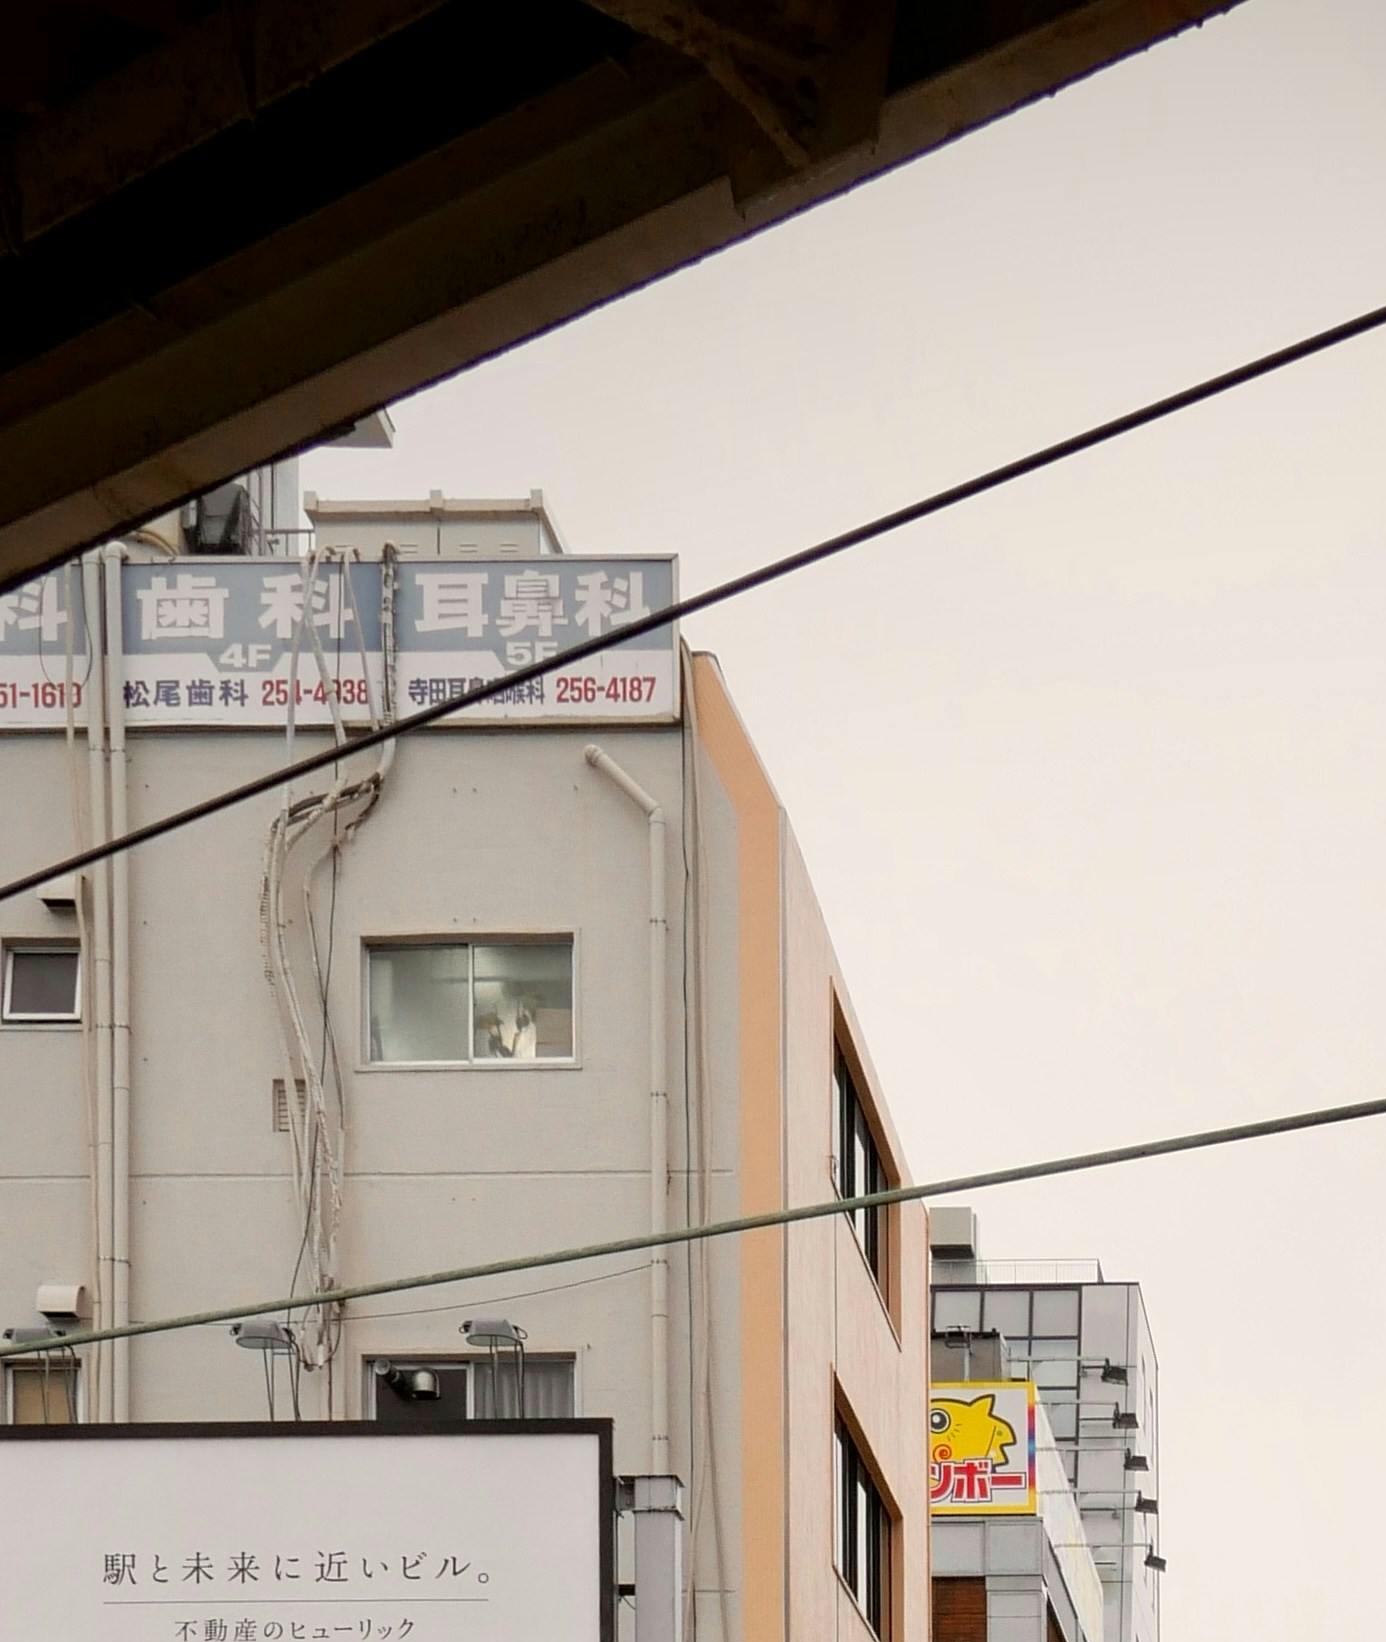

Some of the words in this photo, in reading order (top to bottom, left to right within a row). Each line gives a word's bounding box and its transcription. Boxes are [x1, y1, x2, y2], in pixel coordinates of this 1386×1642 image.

[137, 574, 354, 641] 歯科
[414, 569, 650, 637] 耳鼻科
[219, 644, 272, 668] 4F
[123, 679, 249, 709] 松尾歯科
[556, 677, 657, 704] 256-4187
[103, 1552, 490, 1586] 駅と未来に近いビル。
[174, 1618, 416, 1642] 不動産のヒューリック
